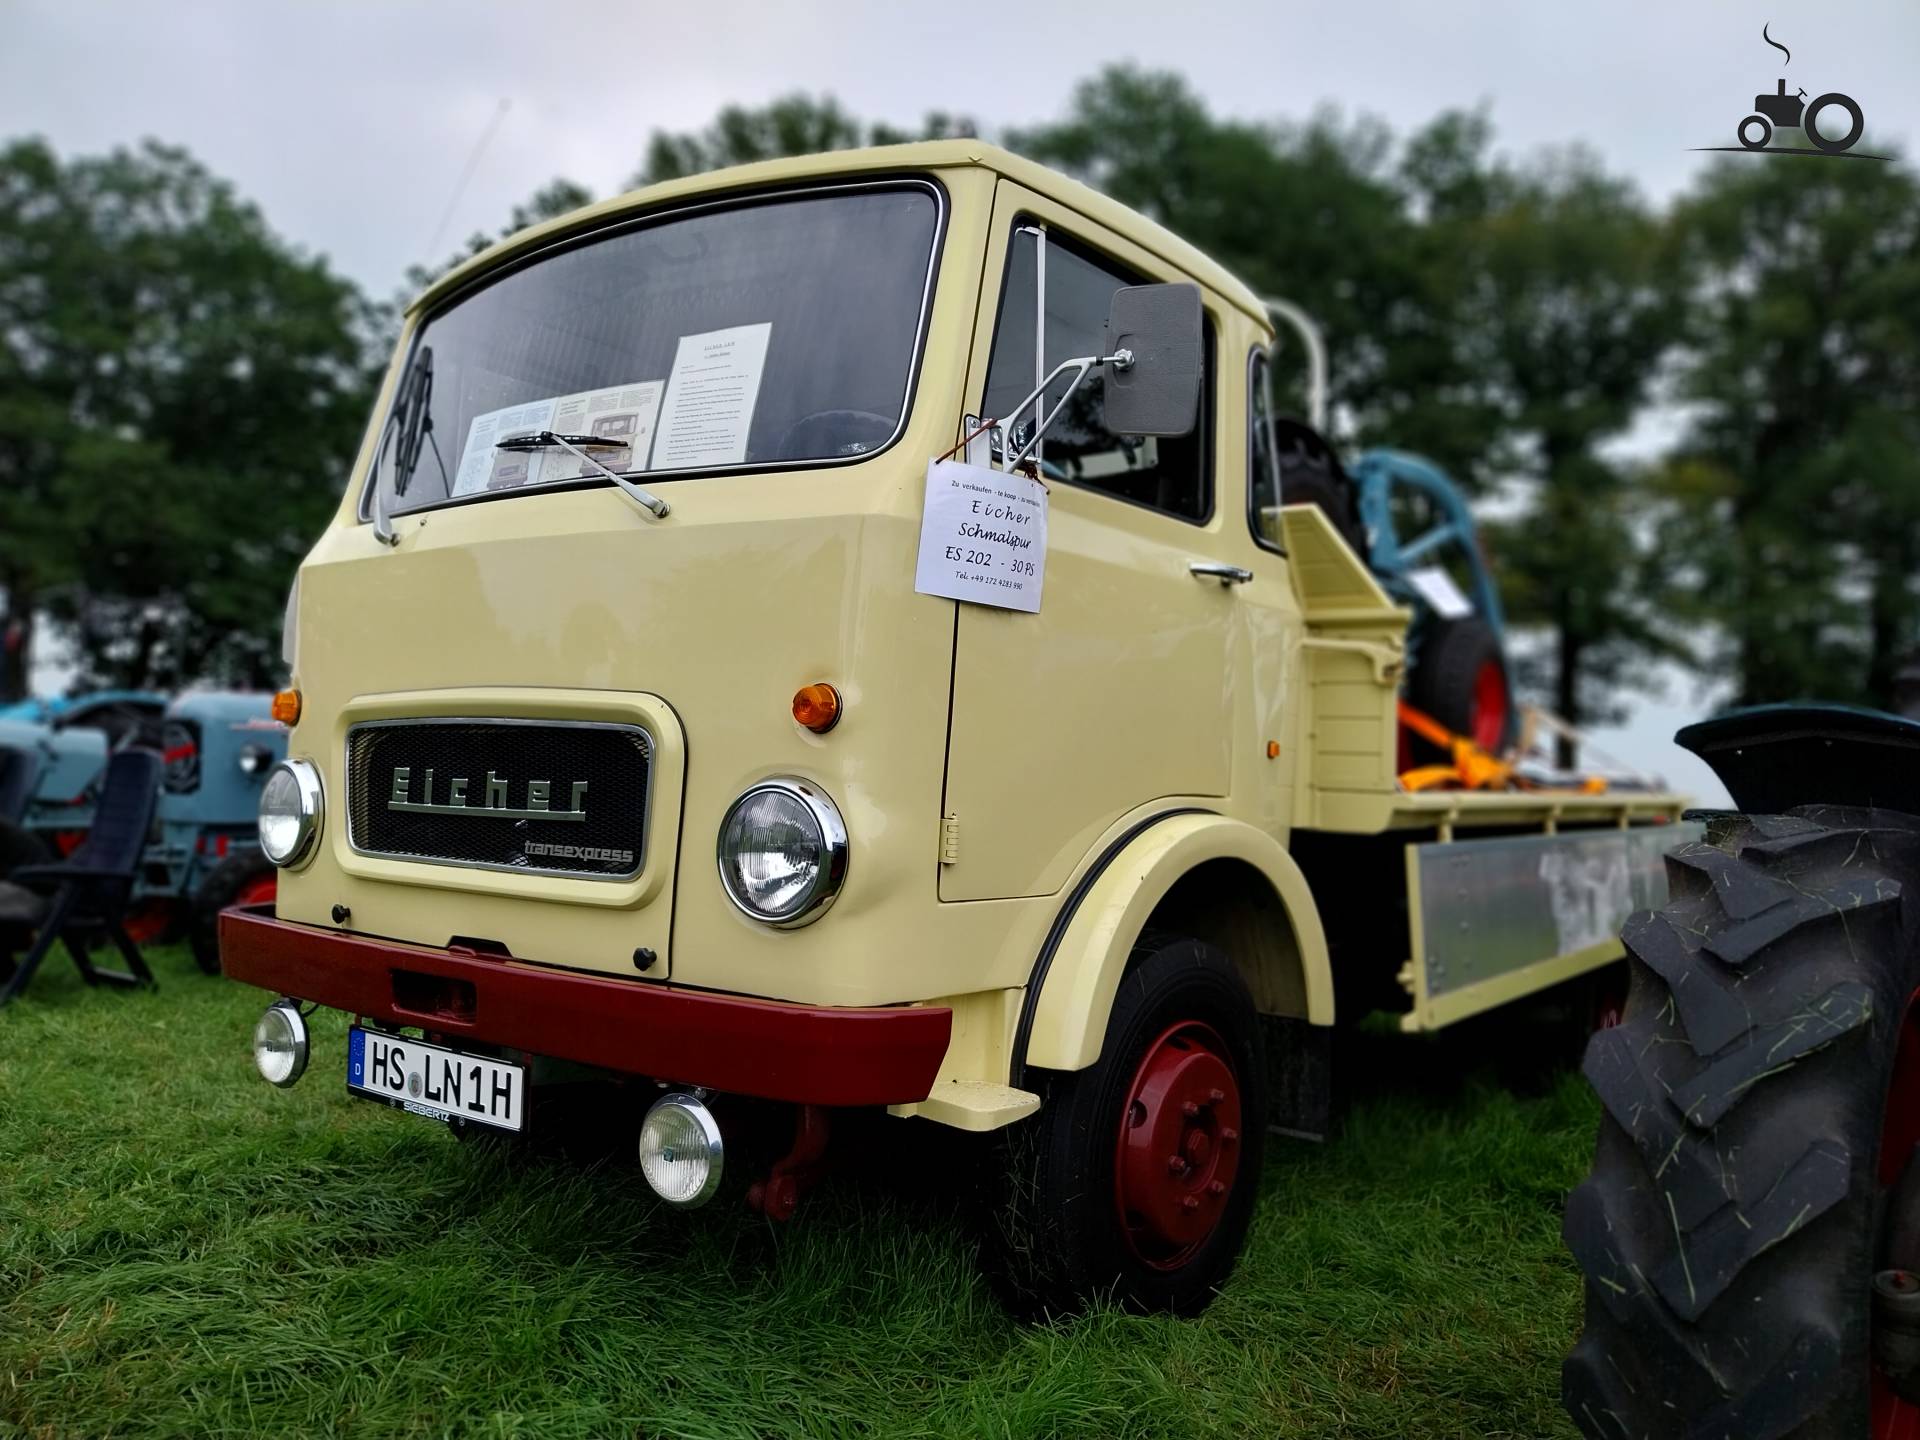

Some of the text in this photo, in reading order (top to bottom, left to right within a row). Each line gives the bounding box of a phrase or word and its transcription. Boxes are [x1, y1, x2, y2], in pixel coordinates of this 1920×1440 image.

[962, 483, 992, 494] verkaufen
[1004, 490, 1017, 501] koop
[972, 500, 1031, 525] Eicher
[958, 522, 1032, 551] Schmalspur
[945, 546, 963, 561] ES
[966, 550, 992, 566] 202
[1011, 559, 1023, 573] 30
[971, 574, 984, 583] +49
[985, 576, 998, 586] 172
[391, 767, 589, 813] Eicher
[524, 840, 634, 864] transexpress
[354, 1063, 361, 1076] D
[372, 1041, 405, 1090] HS
[403, 1100, 450, 1123] SIEBERTZ
